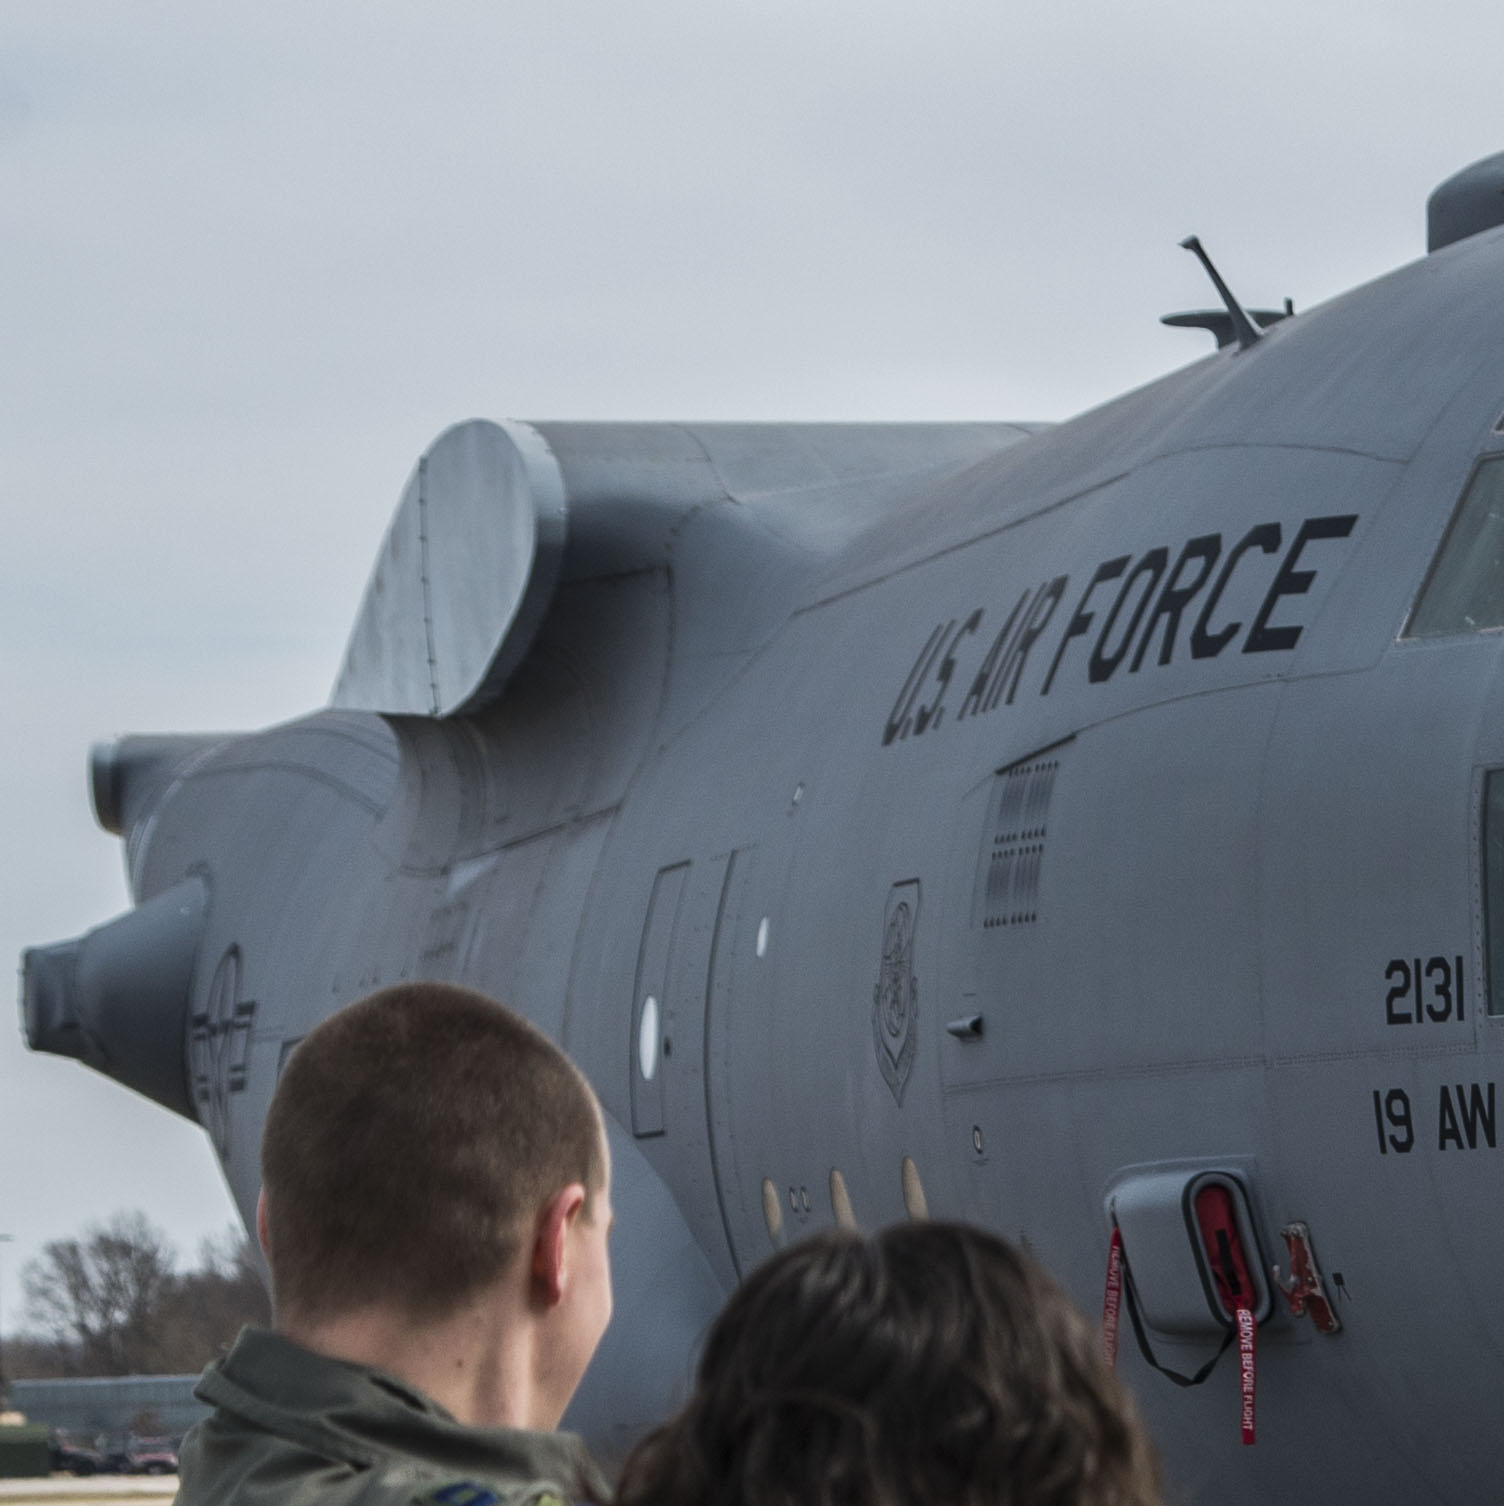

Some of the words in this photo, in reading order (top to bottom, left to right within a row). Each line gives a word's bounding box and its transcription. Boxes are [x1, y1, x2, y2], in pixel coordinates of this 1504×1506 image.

[956, 574, 1069, 720] AIR
[1040, 514, 1359, 695] FORCE
[1384, 955, 1465, 1025] 2131
[1373, 1088, 1415, 1154] 19
[1438, 1083, 1497, 1151] AW
[1107, 1245, 1121, 1288] REMOVE
[1105, 1289, 1119, 1329] BEFORE
[1236, 1309, 1253, 1351] REMOVE
[1241, 1353, 1254, 1392] BEFORE
[1242, 1395, 1253, 1431] FLIGHT
